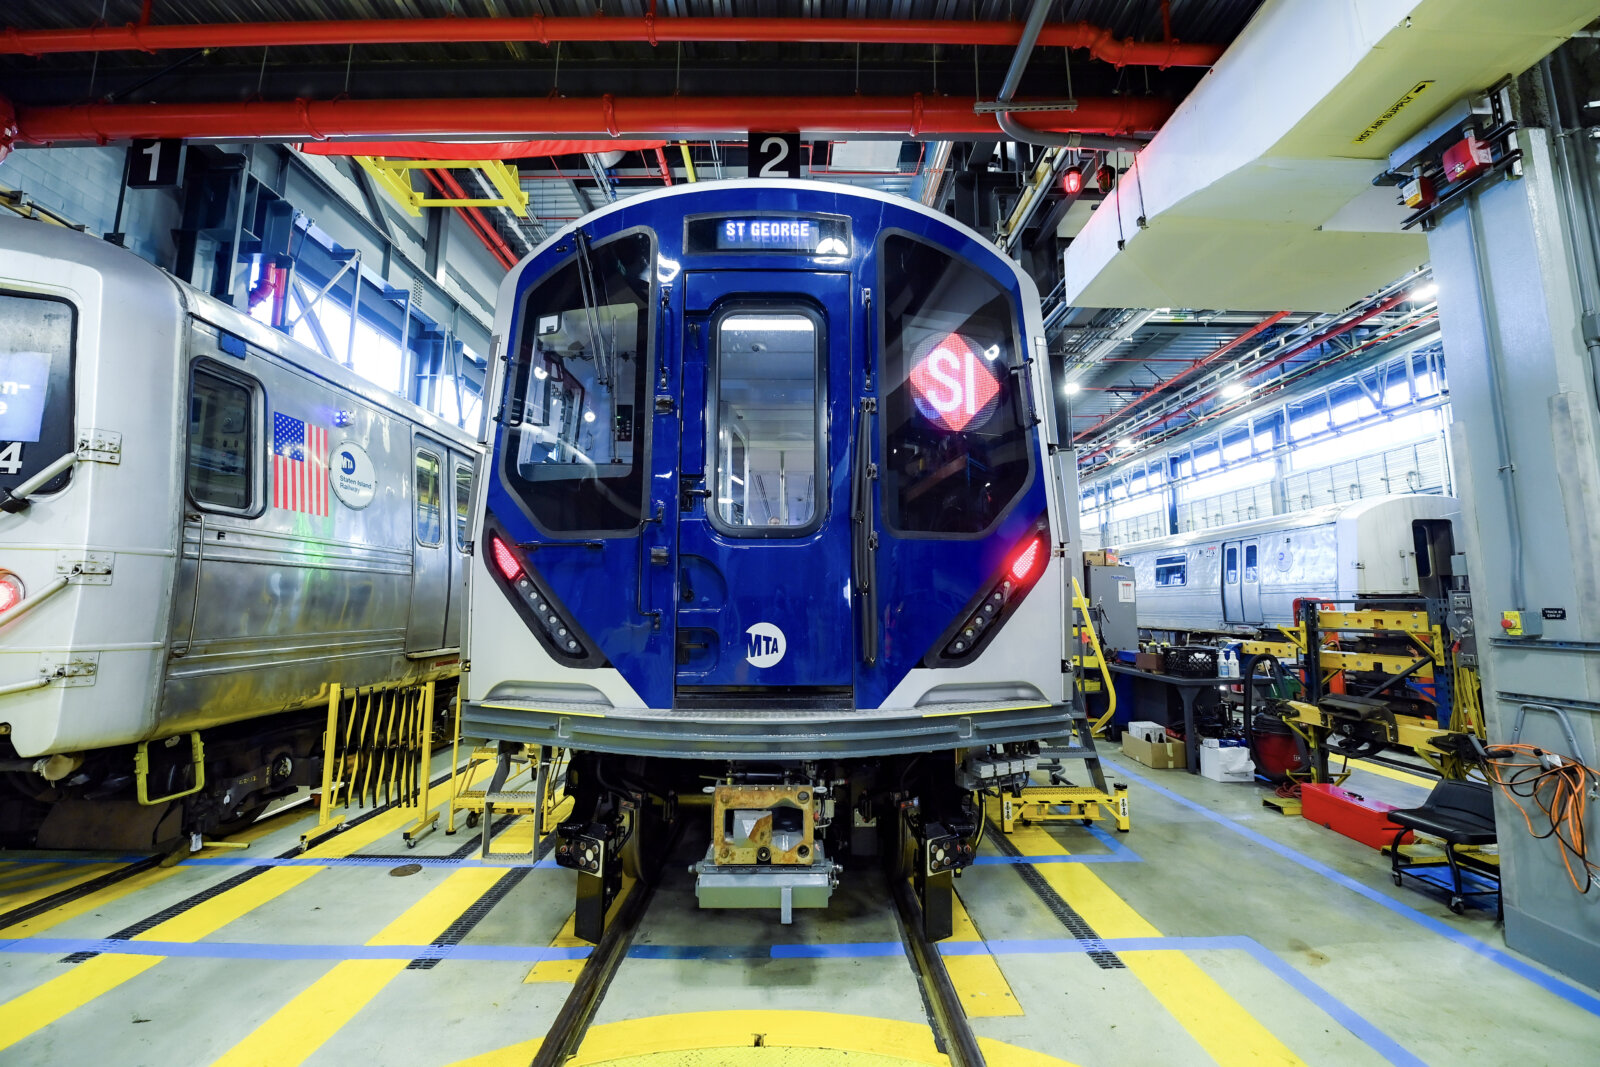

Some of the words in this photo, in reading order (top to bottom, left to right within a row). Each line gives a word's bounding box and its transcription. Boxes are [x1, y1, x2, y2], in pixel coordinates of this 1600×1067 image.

[1356, 130, 1373, 142] HOT
[1371, 119, 1386, 130] AIR
[1383, 96, 1413, 118] SUPPLY
[142, 141, 162, 182] 1
[759, 136, 789, 178] 2
[725, 222, 746, 237] ST
[750, 222, 810, 237] GEORGE
[927, 347, 976, 416] SI
[0, 441, 23, 475] 4
[341, 454, 354, 471] MTA
[340, 474, 357, 485] Staten
[357, 480, 372, 490] Island
[340, 482, 360, 494] Railway
[217, 531, 226, 541] F
[745, 630, 779, 658] MTA
